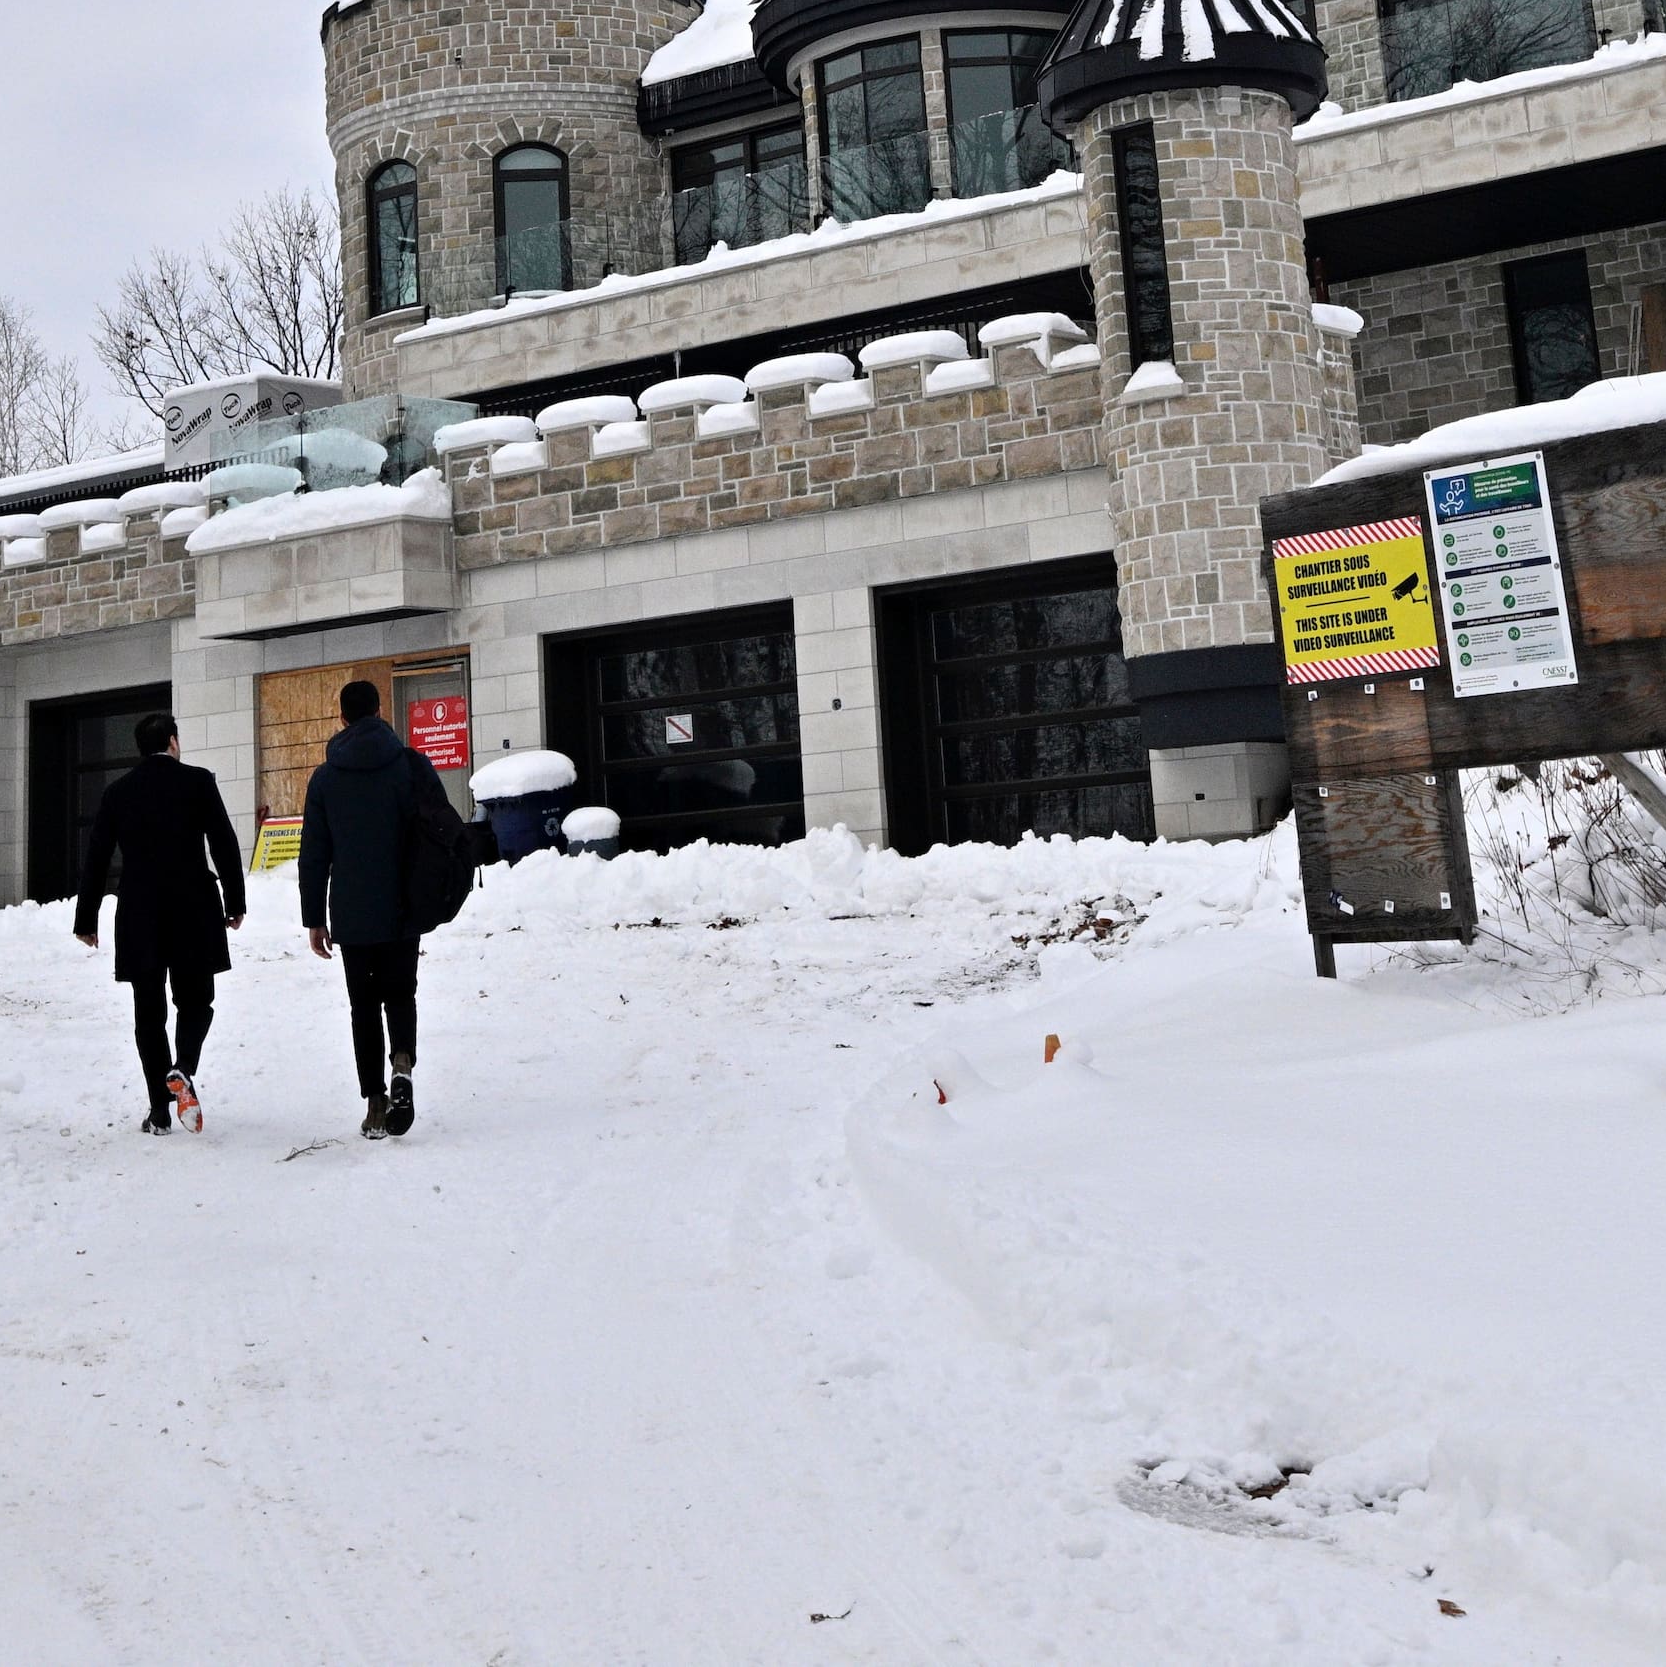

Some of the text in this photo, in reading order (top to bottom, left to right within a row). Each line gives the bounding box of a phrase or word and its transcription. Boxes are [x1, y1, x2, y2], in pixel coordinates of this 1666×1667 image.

[224, 399, 238, 414] Tuck
[286, 399, 301, 410] Tuck
[167, 412, 181, 426] Tuck
[171, 407, 212, 447] NovaWrap
[1294, 554, 1370, 579] CHANTIER SOUS
[1287, 569, 1387, 600] SURVEILLANCE VIDÉO
[1295, 607, 1388, 633] THIS SITE IS UNDER
[1294, 626, 1395, 653] VIDEO SURVEILLANCE
[1542, 665, 1568, 676] CNESST
[413, 721, 466, 734] Personnel autorisé
[425, 733, 455, 742] seulement
[430, 755, 462, 765] onnel only
